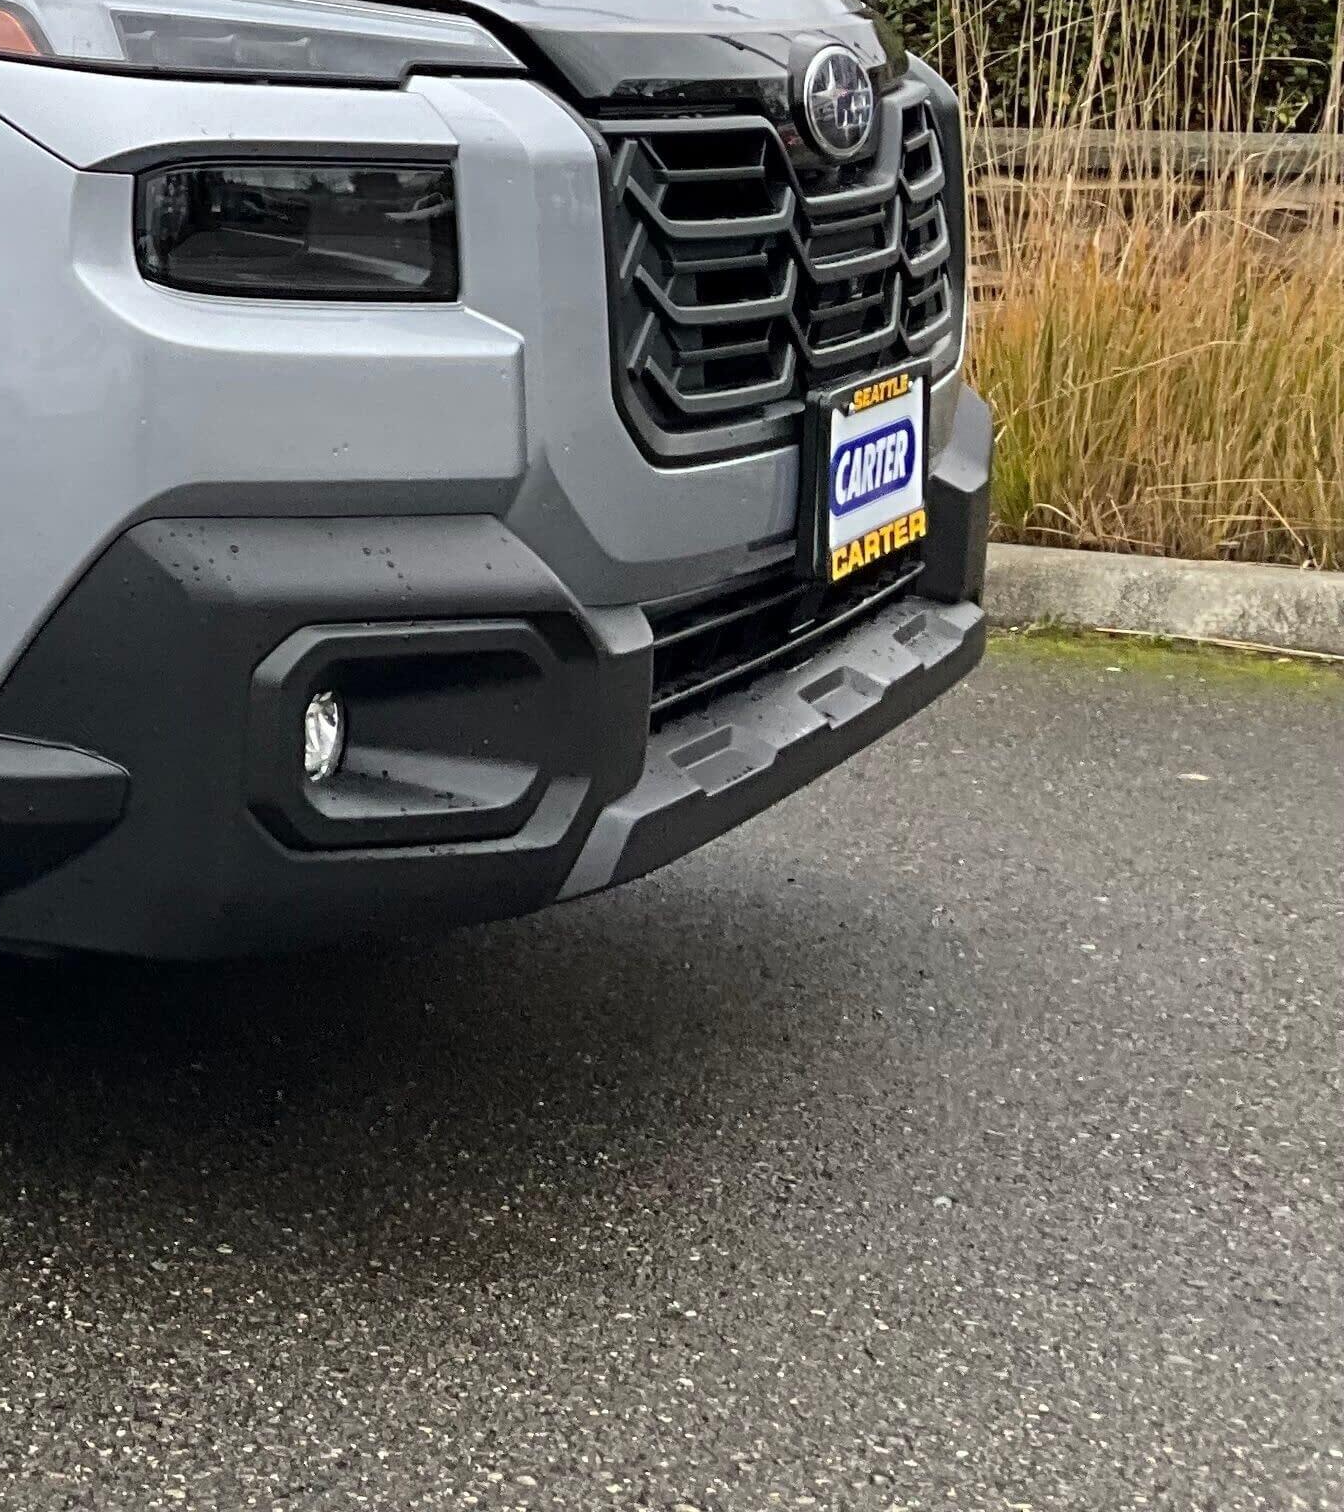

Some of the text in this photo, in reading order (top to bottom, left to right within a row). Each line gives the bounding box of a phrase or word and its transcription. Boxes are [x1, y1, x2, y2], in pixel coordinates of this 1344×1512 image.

[853, 373, 909, 410] SEATTLE
[835, 429, 909, 505] CARTER
[831, 509, 927, 581] CARTER
